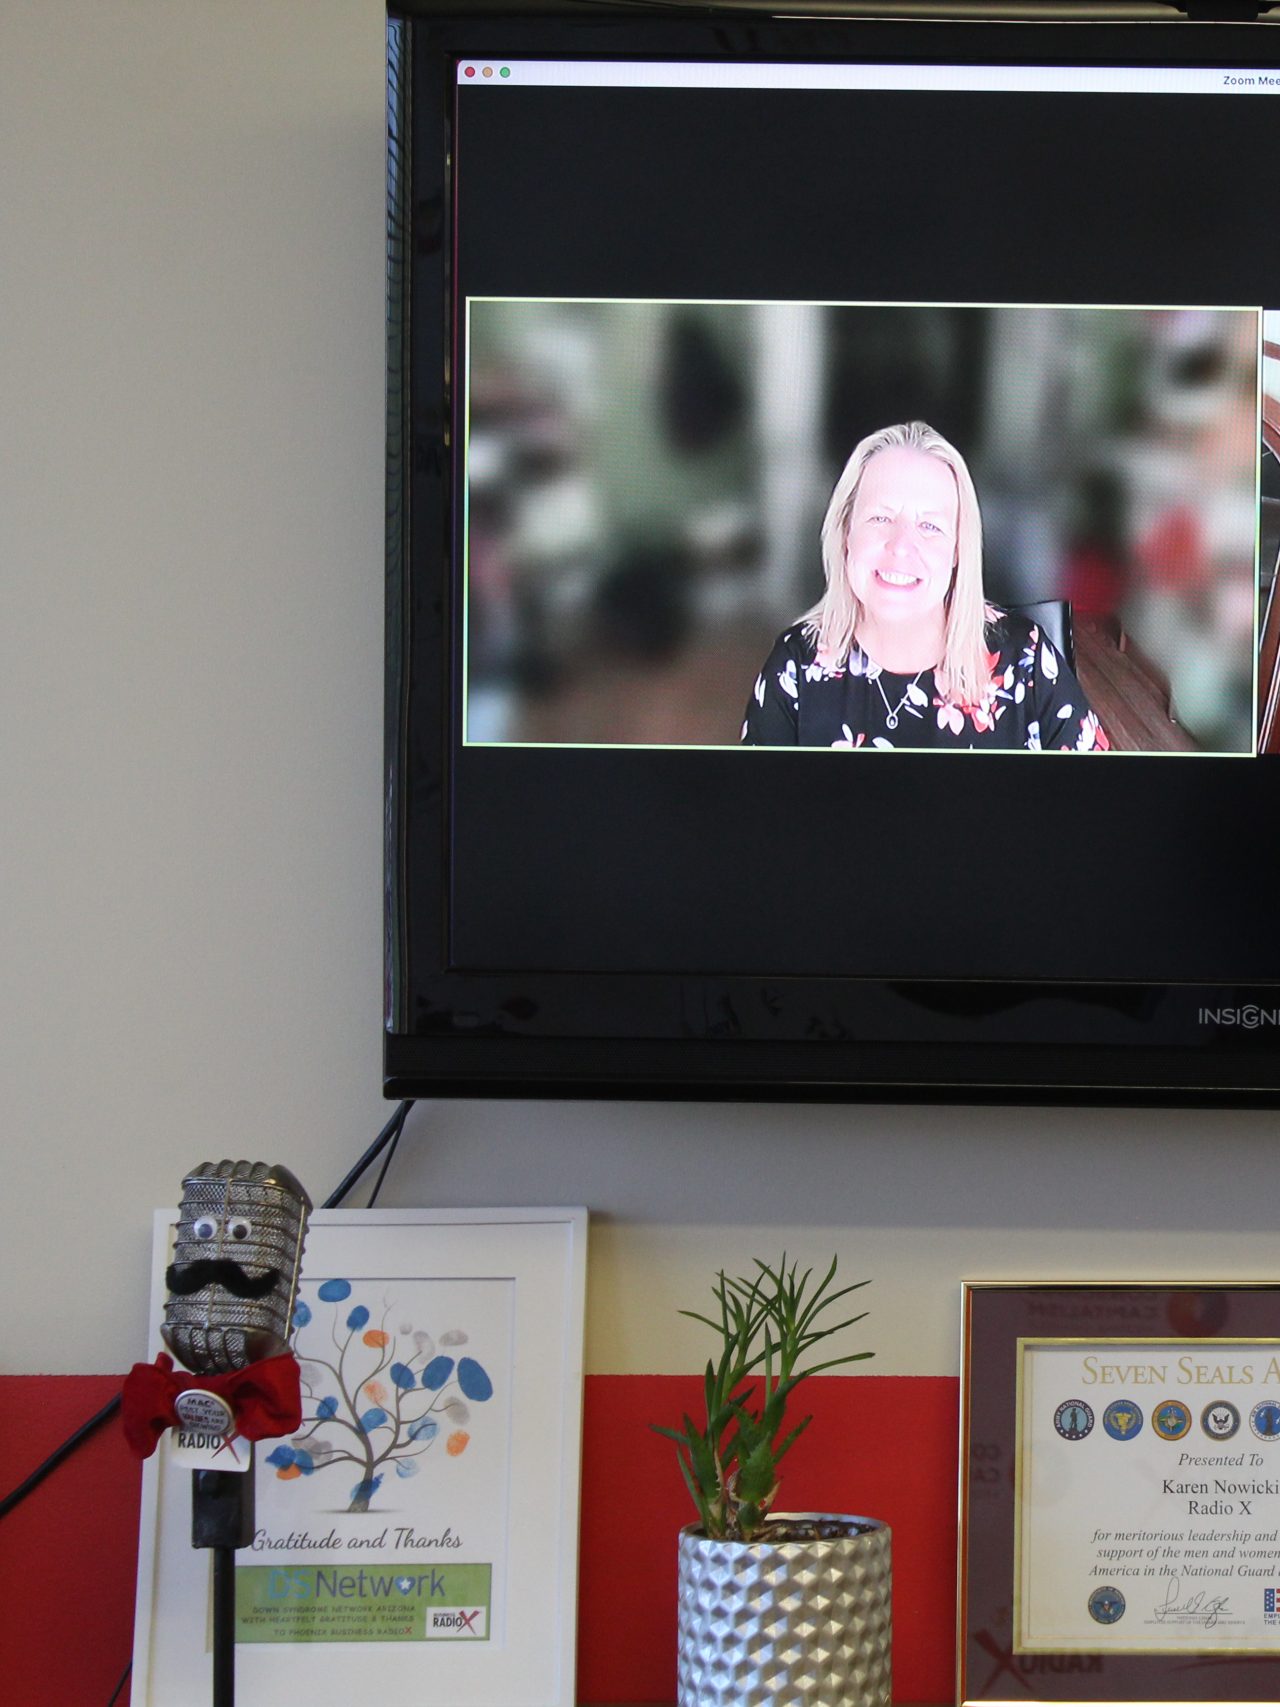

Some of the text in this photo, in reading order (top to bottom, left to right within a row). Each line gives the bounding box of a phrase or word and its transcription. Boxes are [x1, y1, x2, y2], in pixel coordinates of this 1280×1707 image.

[1223, 76, 1255, 85] Zoom
[1178, 1453, 1264, 1466] Presented To
[1162, 1480, 1279, 1494] Karen Nowicki
[1188, 1500, 1252, 1515] Radio X
[251, 1528, 463, 1550] Gratitude and Thanks
[1090, 1529, 1111, 1544] for
[1114, 1530, 1184, 1541] meritorious
[1188, 1529, 1251, 1544] leadership
[1254, 1530, 1278, 1542] and
[1096, 1549, 1144, 1560] support
[1147, 1546, 1162, 1560] of
[1162, 1546, 1181, 1558] the
[1184, 1550, 1208, 1558] men
[1212, 1547, 1236, 1559] and
[1239, 1550, 1280, 1559] women
[1089, 1564, 1140, 1576] America
[1143, 1565, 1155, 1576] in
[1159, 1564, 1178, 1576] the
[1181, 1564, 1234, 1577] National
[1238, 1565, 1275, 1577] Guard
